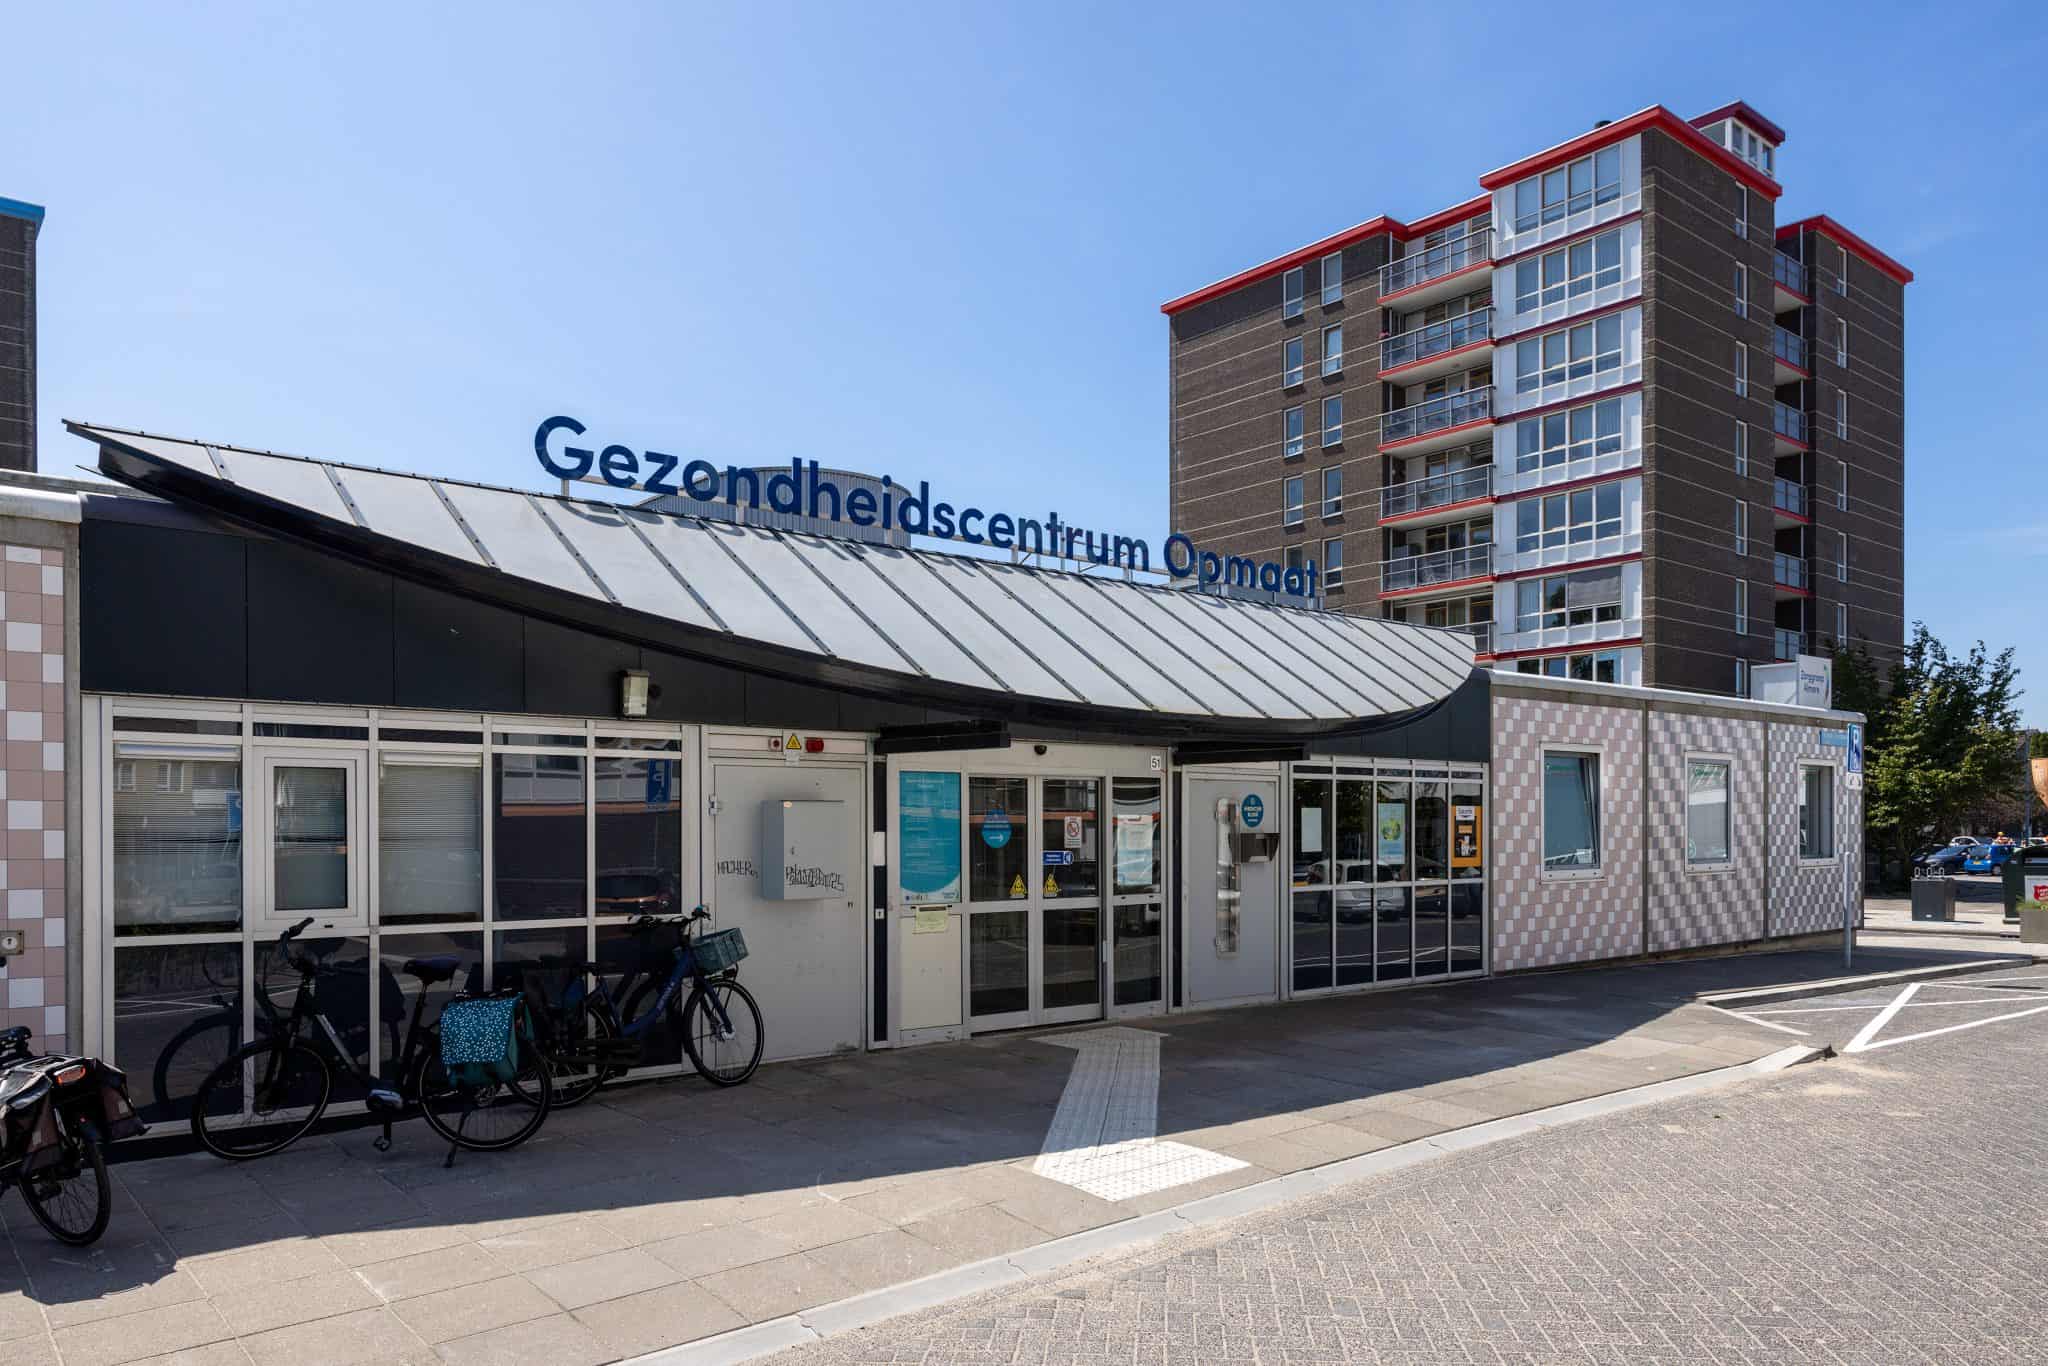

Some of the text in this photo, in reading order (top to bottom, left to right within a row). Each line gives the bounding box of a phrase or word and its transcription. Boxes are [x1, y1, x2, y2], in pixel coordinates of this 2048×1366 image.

[534, 415, 1318, 598] Gezondheidscentrum Opmaat
[1151, 756, 1160, 769] 51
